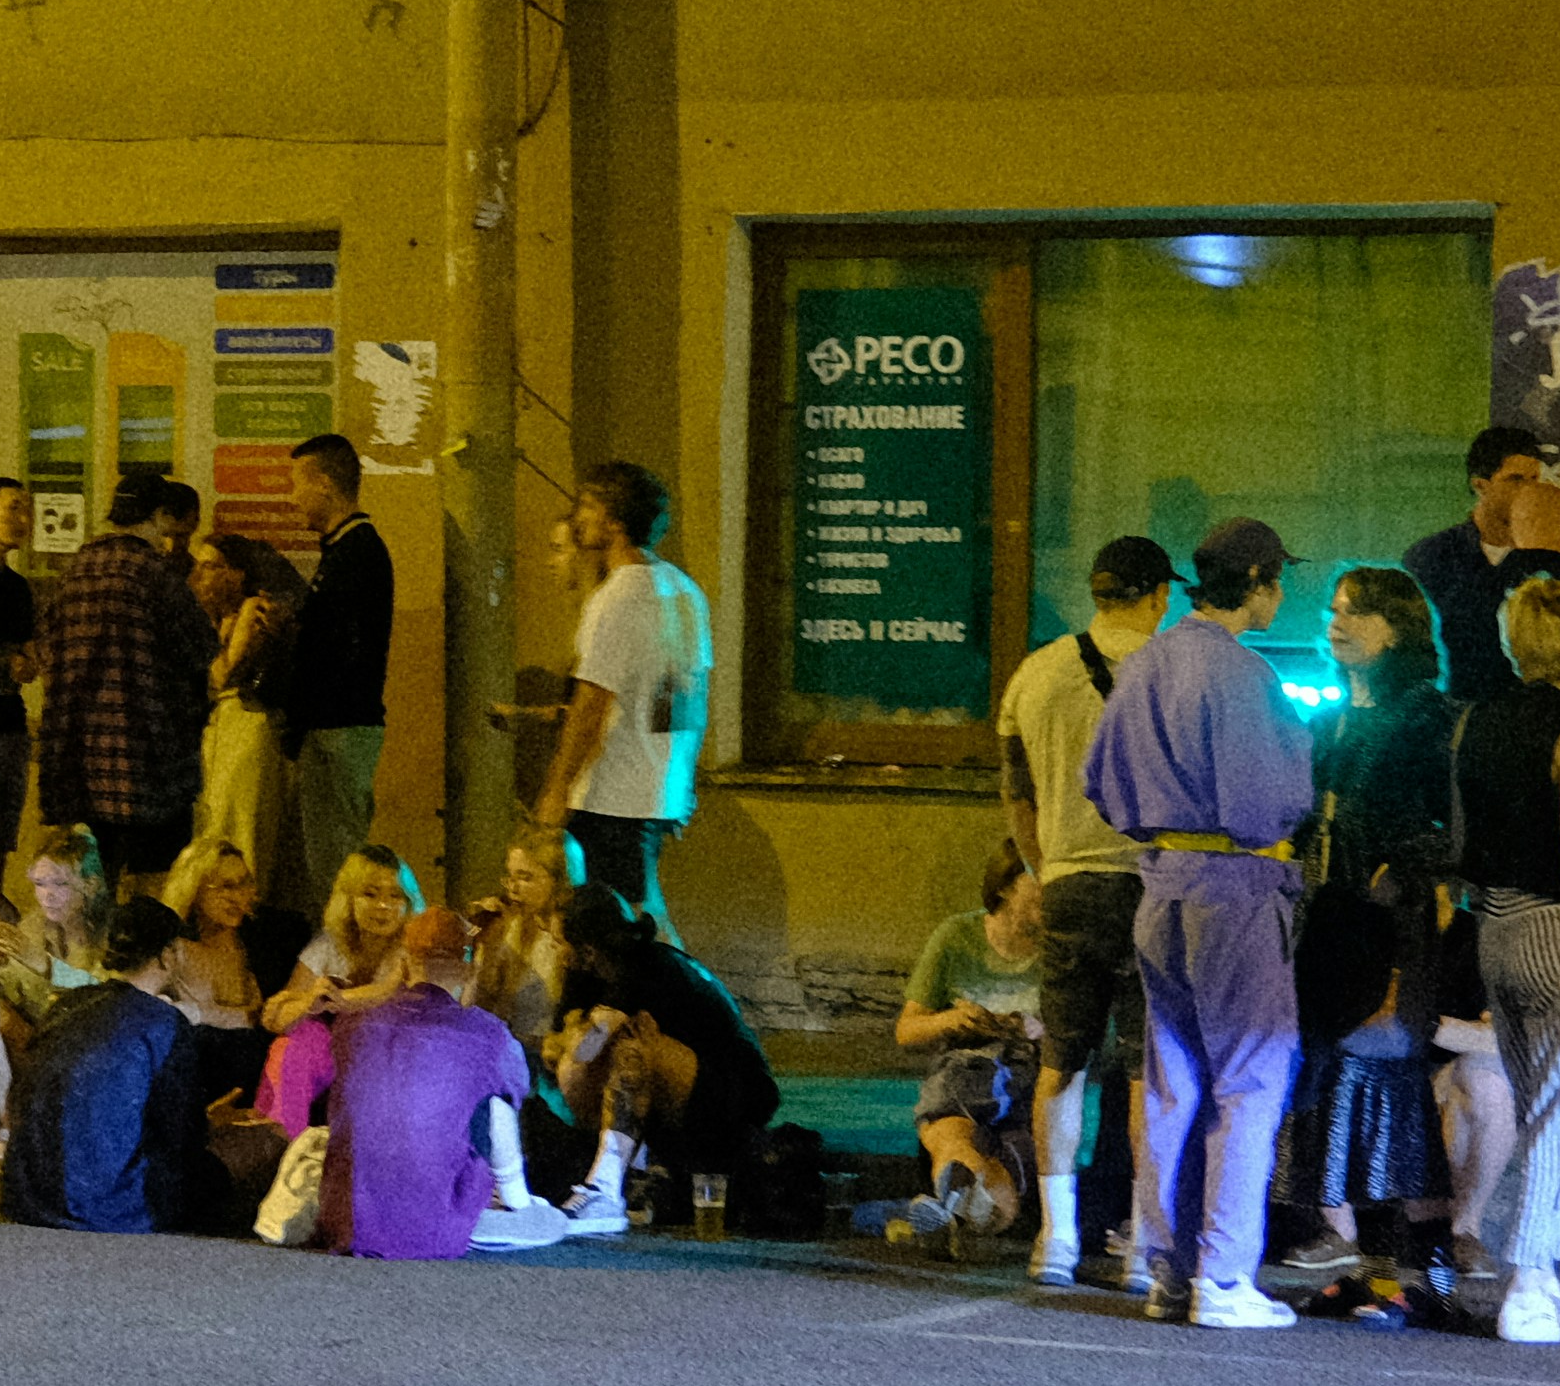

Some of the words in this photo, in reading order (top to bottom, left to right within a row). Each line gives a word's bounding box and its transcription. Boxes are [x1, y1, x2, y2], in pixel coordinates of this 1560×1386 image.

[805, 405, 966, 429] СТРАХОВАНИЕ
[800, 619, 865, 644] ЗДЕСЬ
[869, 620, 884, 641] И
[888, 617, 966, 642] СЕЙЧАС
